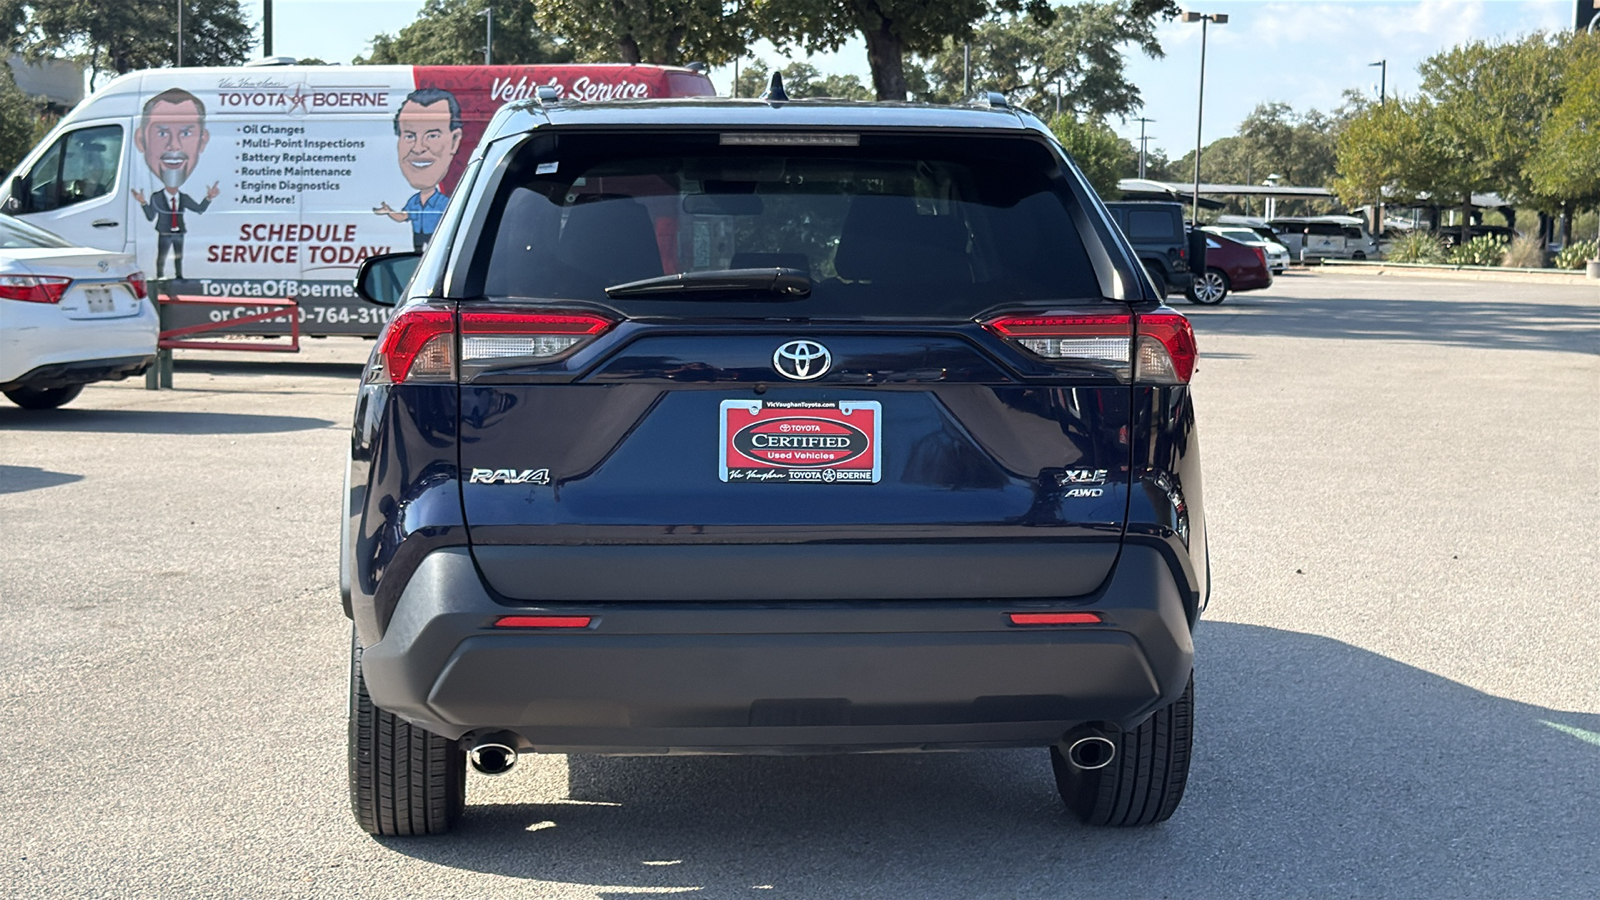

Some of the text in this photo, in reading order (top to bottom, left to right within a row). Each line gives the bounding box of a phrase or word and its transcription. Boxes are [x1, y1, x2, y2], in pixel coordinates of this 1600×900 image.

[568, 76, 649, 101] Service
[218, 92, 287, 107] TOYOTA
[312, 92, 389, 107] BOERNE
[242, 125, 305, 136] Oil Changes
[242, 139, 365, 150] Multi-Point Inspections
[241, 153, 357, 164] Battery Replacements
[241, 167, 352, 177] Routine Maintenance
[241, 181, 340, 193] Engine Diagnostics
[240, 195, 295, 205] And More!
[239, 224, 357, 242] SCHEDULE
[207, 245, 298, 263] SERVICE
[209, 308, 231, 323] or
[274, 306, 392, 324] 20-764-311
[795, 452, 835, 460] Vehicles
[469, 468, 550, 485] RAV4
[746, 469, 787, 482] Vaughan
[789, 471, 821, 479] TOYOTA
[837, 471, 872, 479] BOERNE
[1061, 470, 1108, 483] XLE
[1064, 488, 1104, 498] AWD
